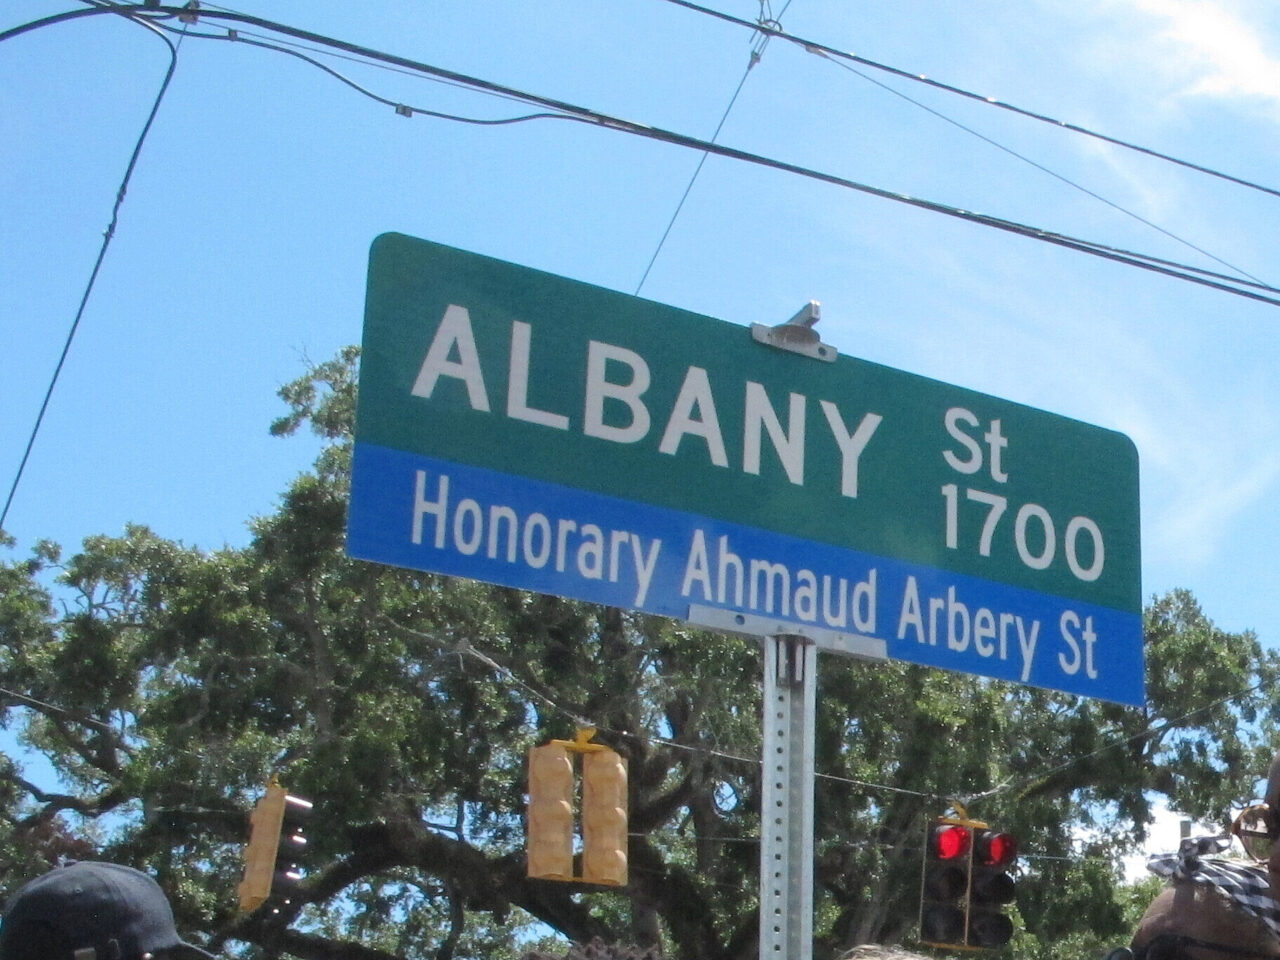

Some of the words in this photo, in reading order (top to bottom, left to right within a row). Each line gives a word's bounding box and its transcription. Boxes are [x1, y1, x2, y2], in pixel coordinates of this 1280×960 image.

[410, 303, 884, 498] ALBANY
[941, 406, 1009, 483] St
[411, 470, 661, 608] Honorary
[681, 529, 877, 633] Ahmaud
[897, 576, 1039, 681] Arbery
[1058, 611, 1098, 679] St
[939, 483, 1107, 582] 1700
